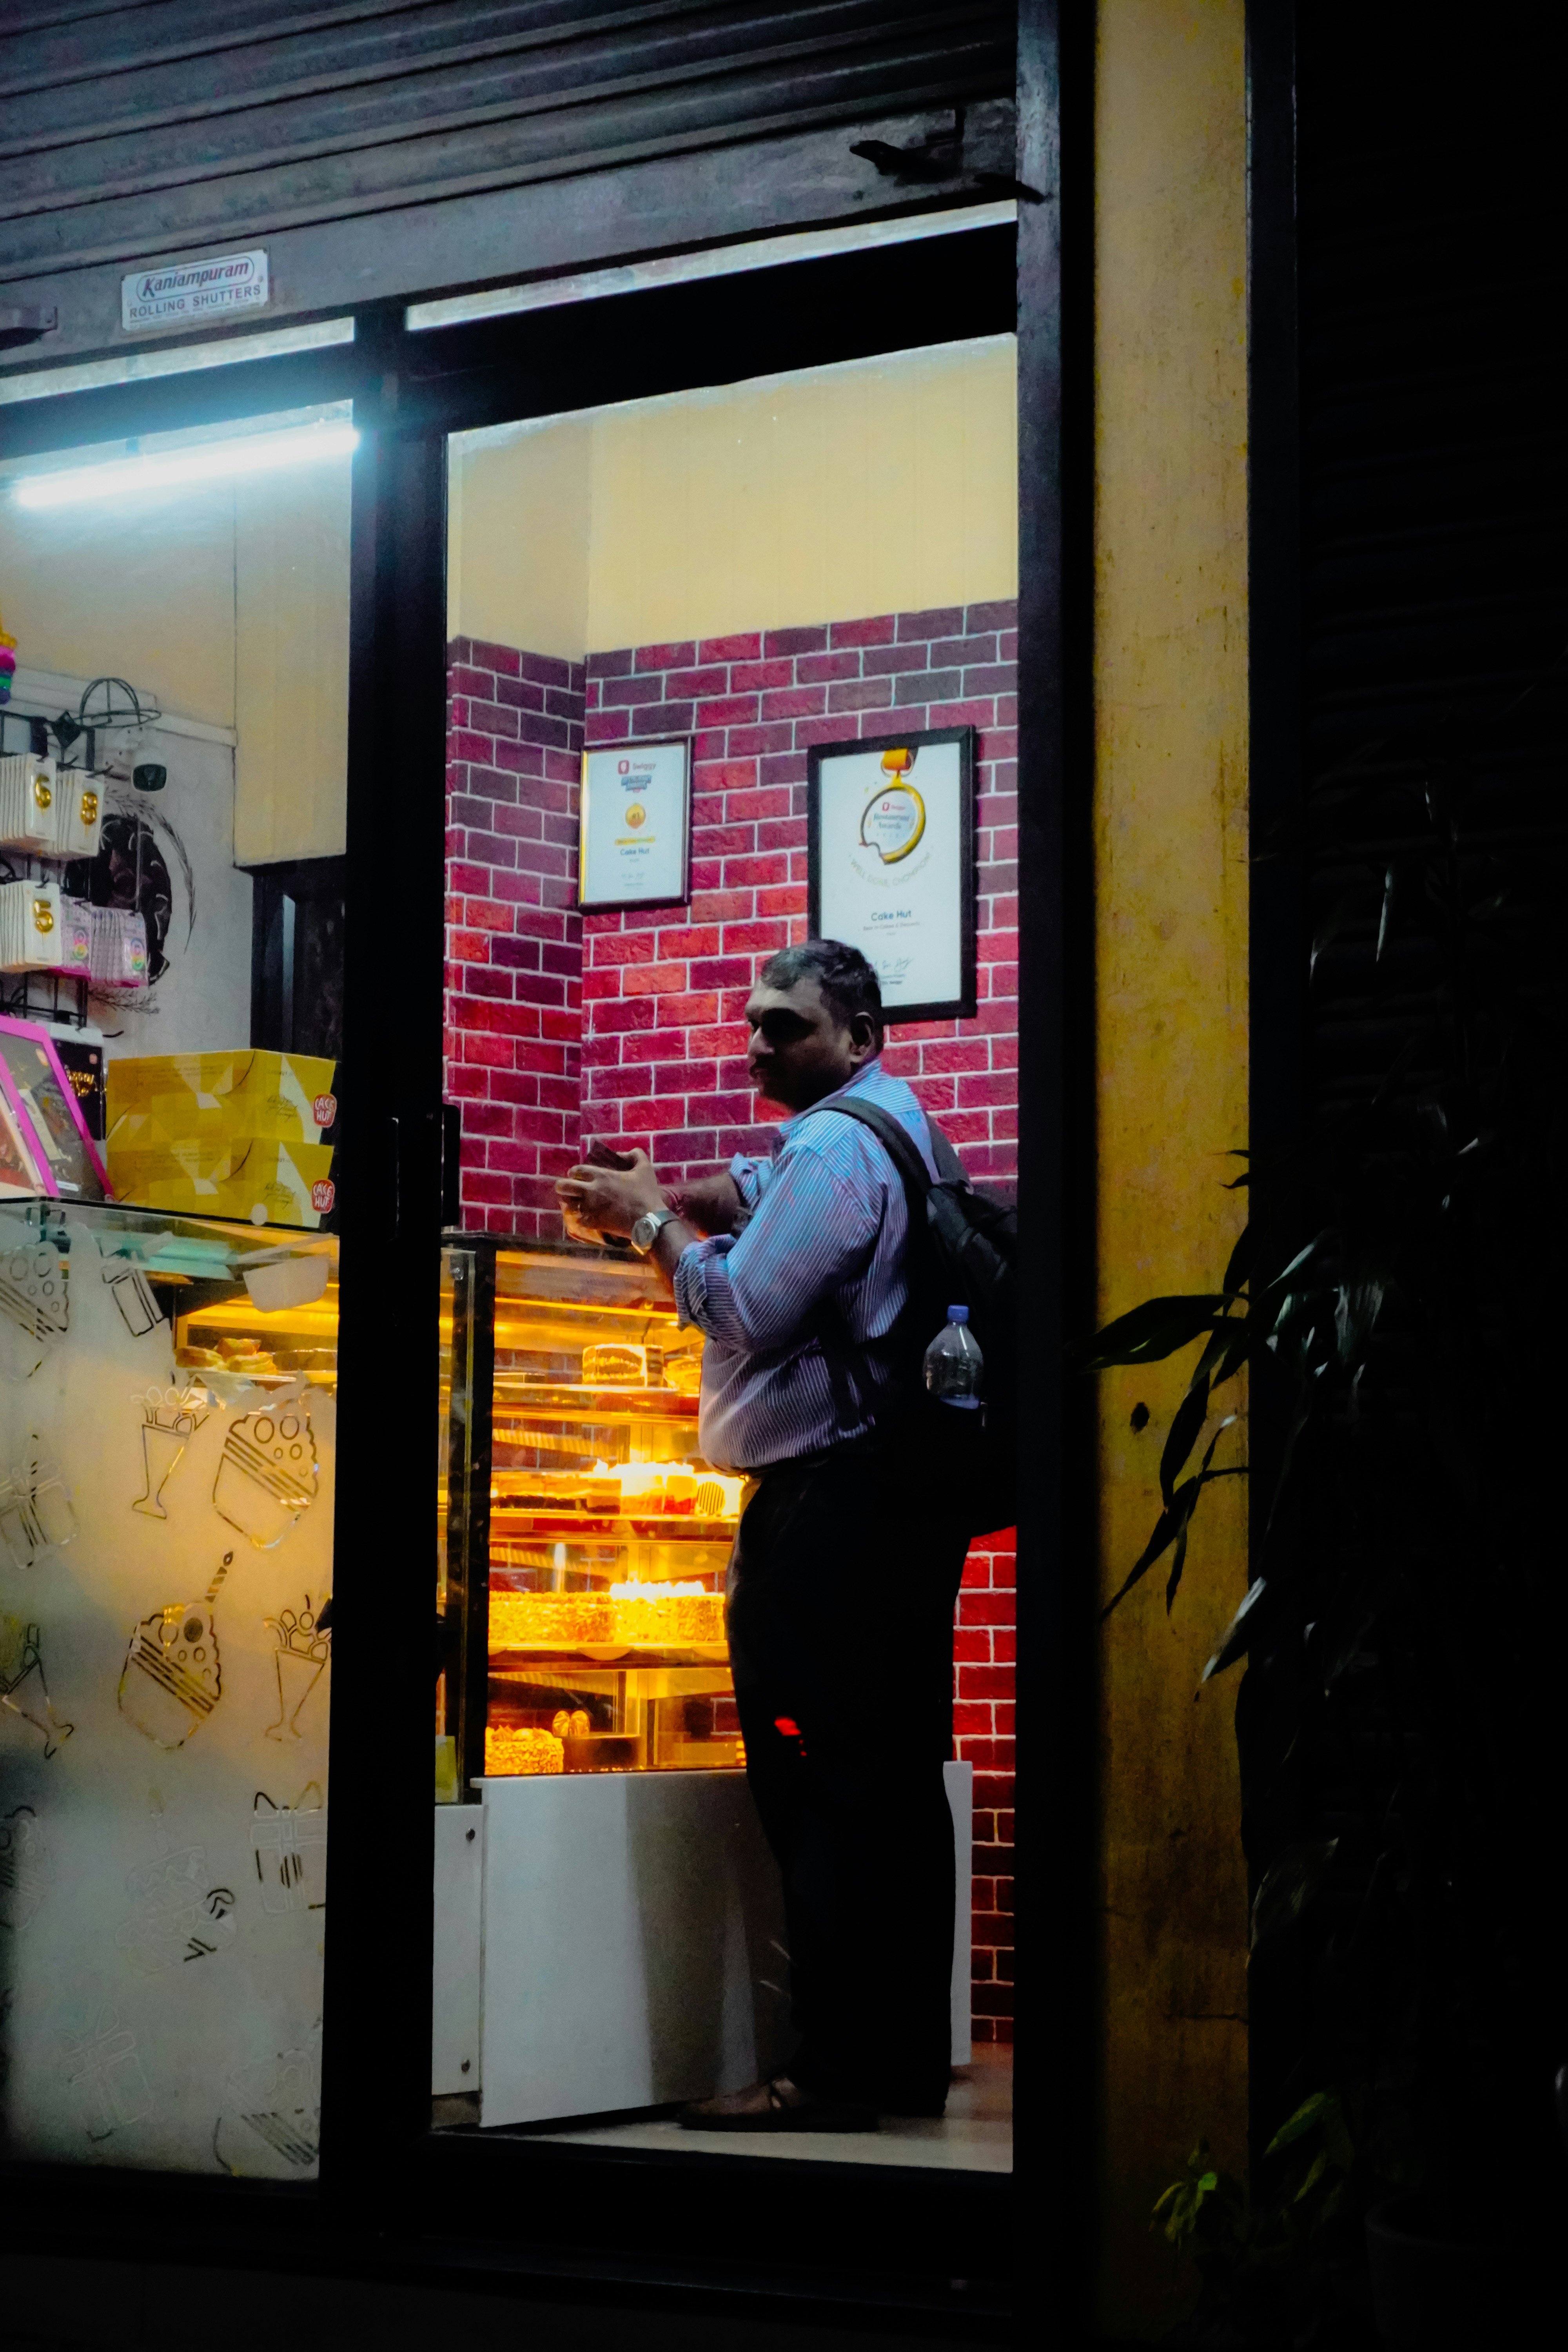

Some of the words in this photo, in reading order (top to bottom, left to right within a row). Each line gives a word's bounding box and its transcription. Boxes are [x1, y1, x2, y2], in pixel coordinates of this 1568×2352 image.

[142, 263, 249, 298] Kaniampuram
[130, 299, 185, 318] ROLLING
[193, 285, 261, 306] SHUTTERS
[36, 773, 51, 809] 6
[81, 791, 97, 825] 8
[34, 899, 54, 933] 5
[871, 912, 893, 921] Cake
[316, 1110, 331, 1121] HUT
[315, 1196, 330, 1208] HUT
